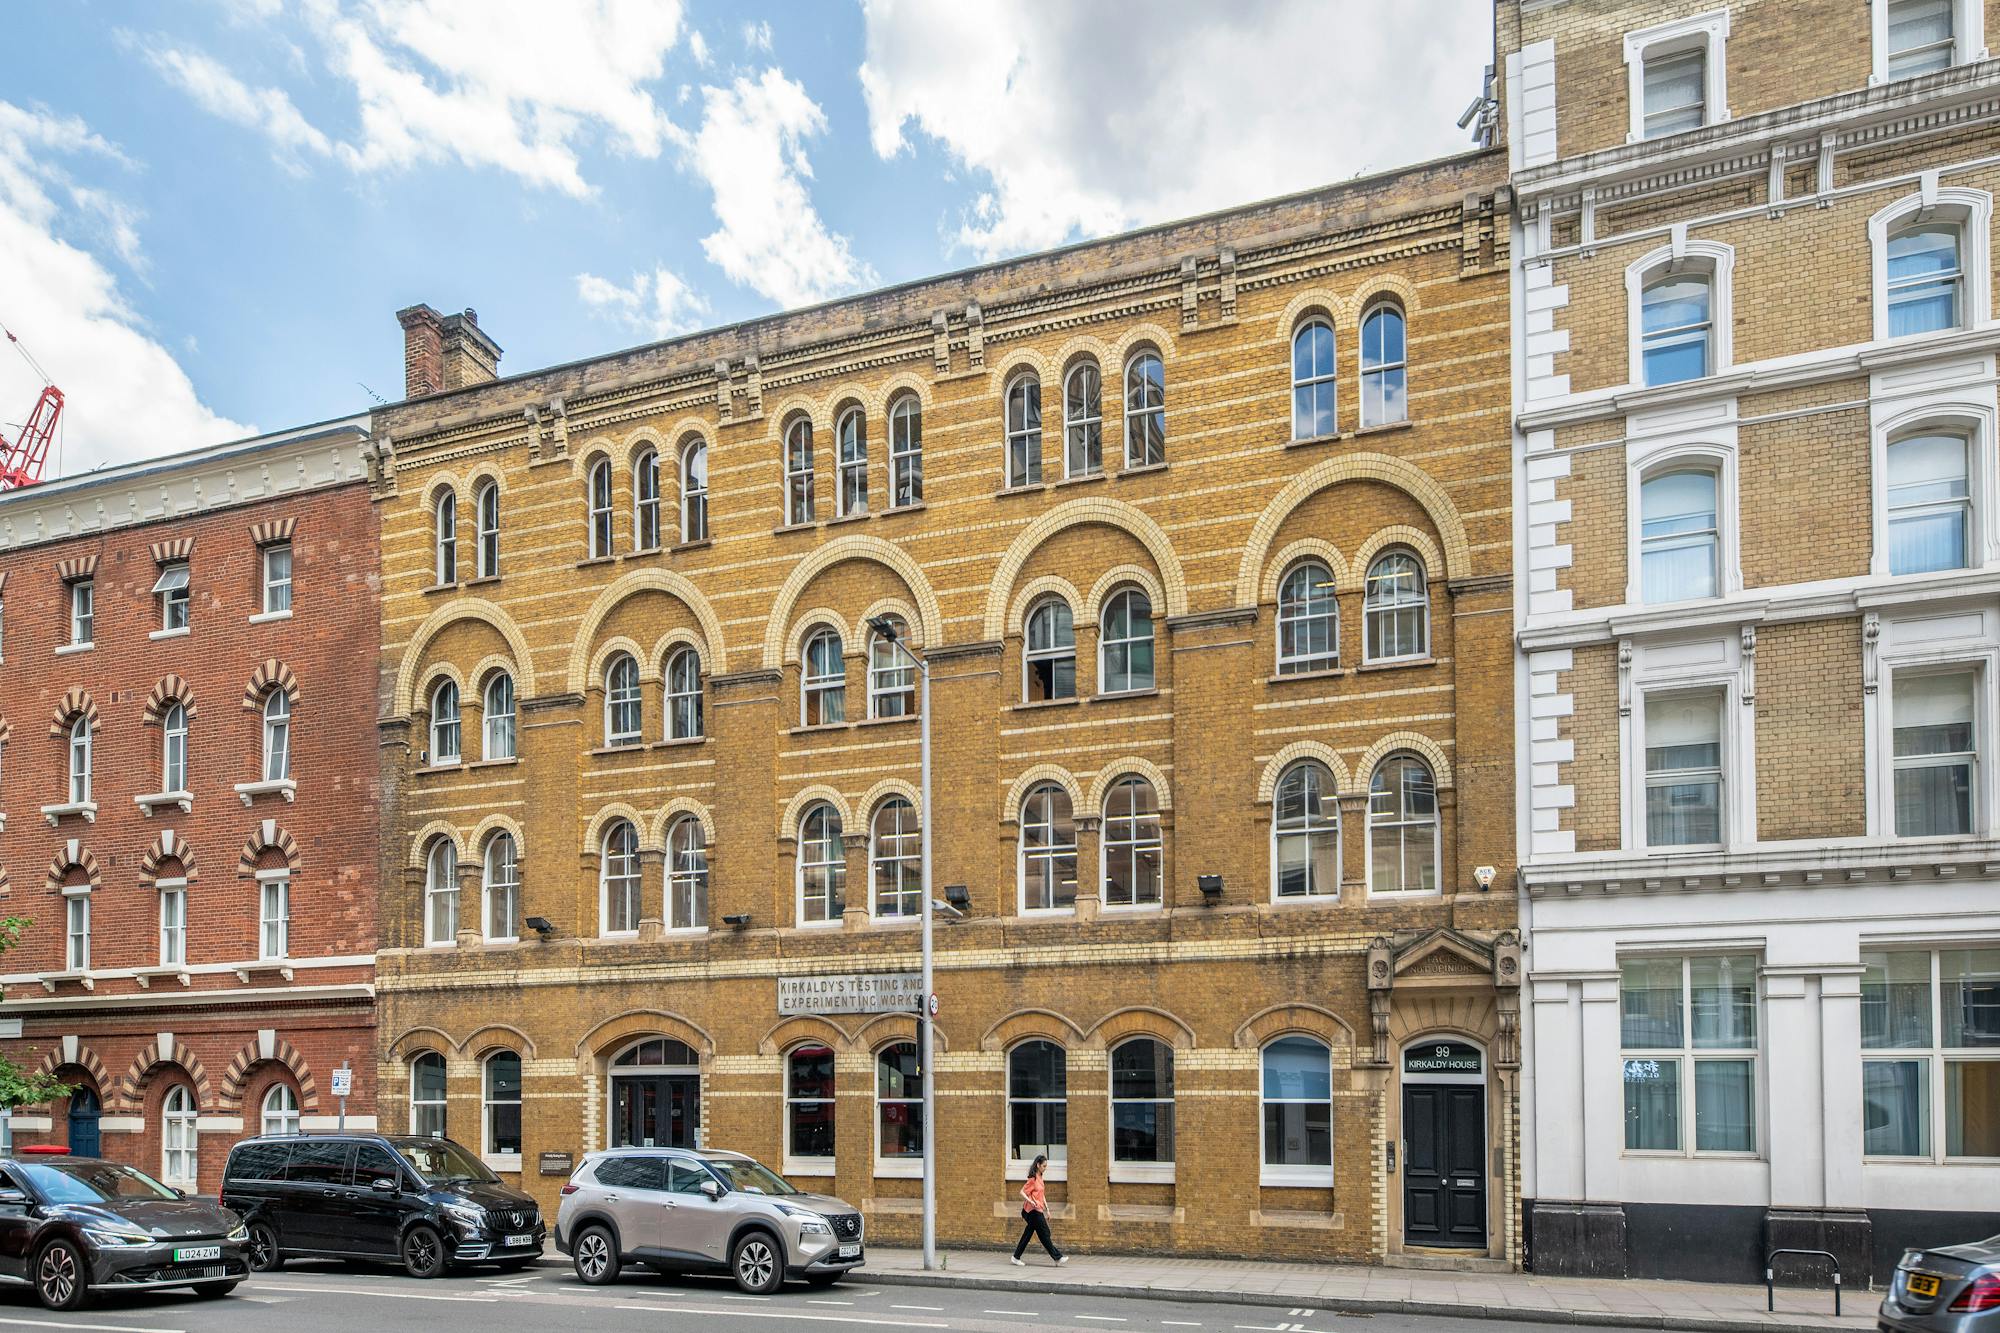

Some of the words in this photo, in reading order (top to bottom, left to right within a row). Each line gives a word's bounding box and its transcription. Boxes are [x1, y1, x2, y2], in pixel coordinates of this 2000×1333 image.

[780, 980, 845, 995] KIRKALDY'S
[850, 979, 898, 992] TESTING
[902, 979, 923, 990] AND
[784, 995, 876, 1009] EXPERIMENTING
[881, 993, 919, 1005] WORKS
[1435, 1046, 1450, 1058] 99
[1408, 1060, 1447, 1069] KIRKALDY
[1449, 1060, 1478, 1069] HOUSE
